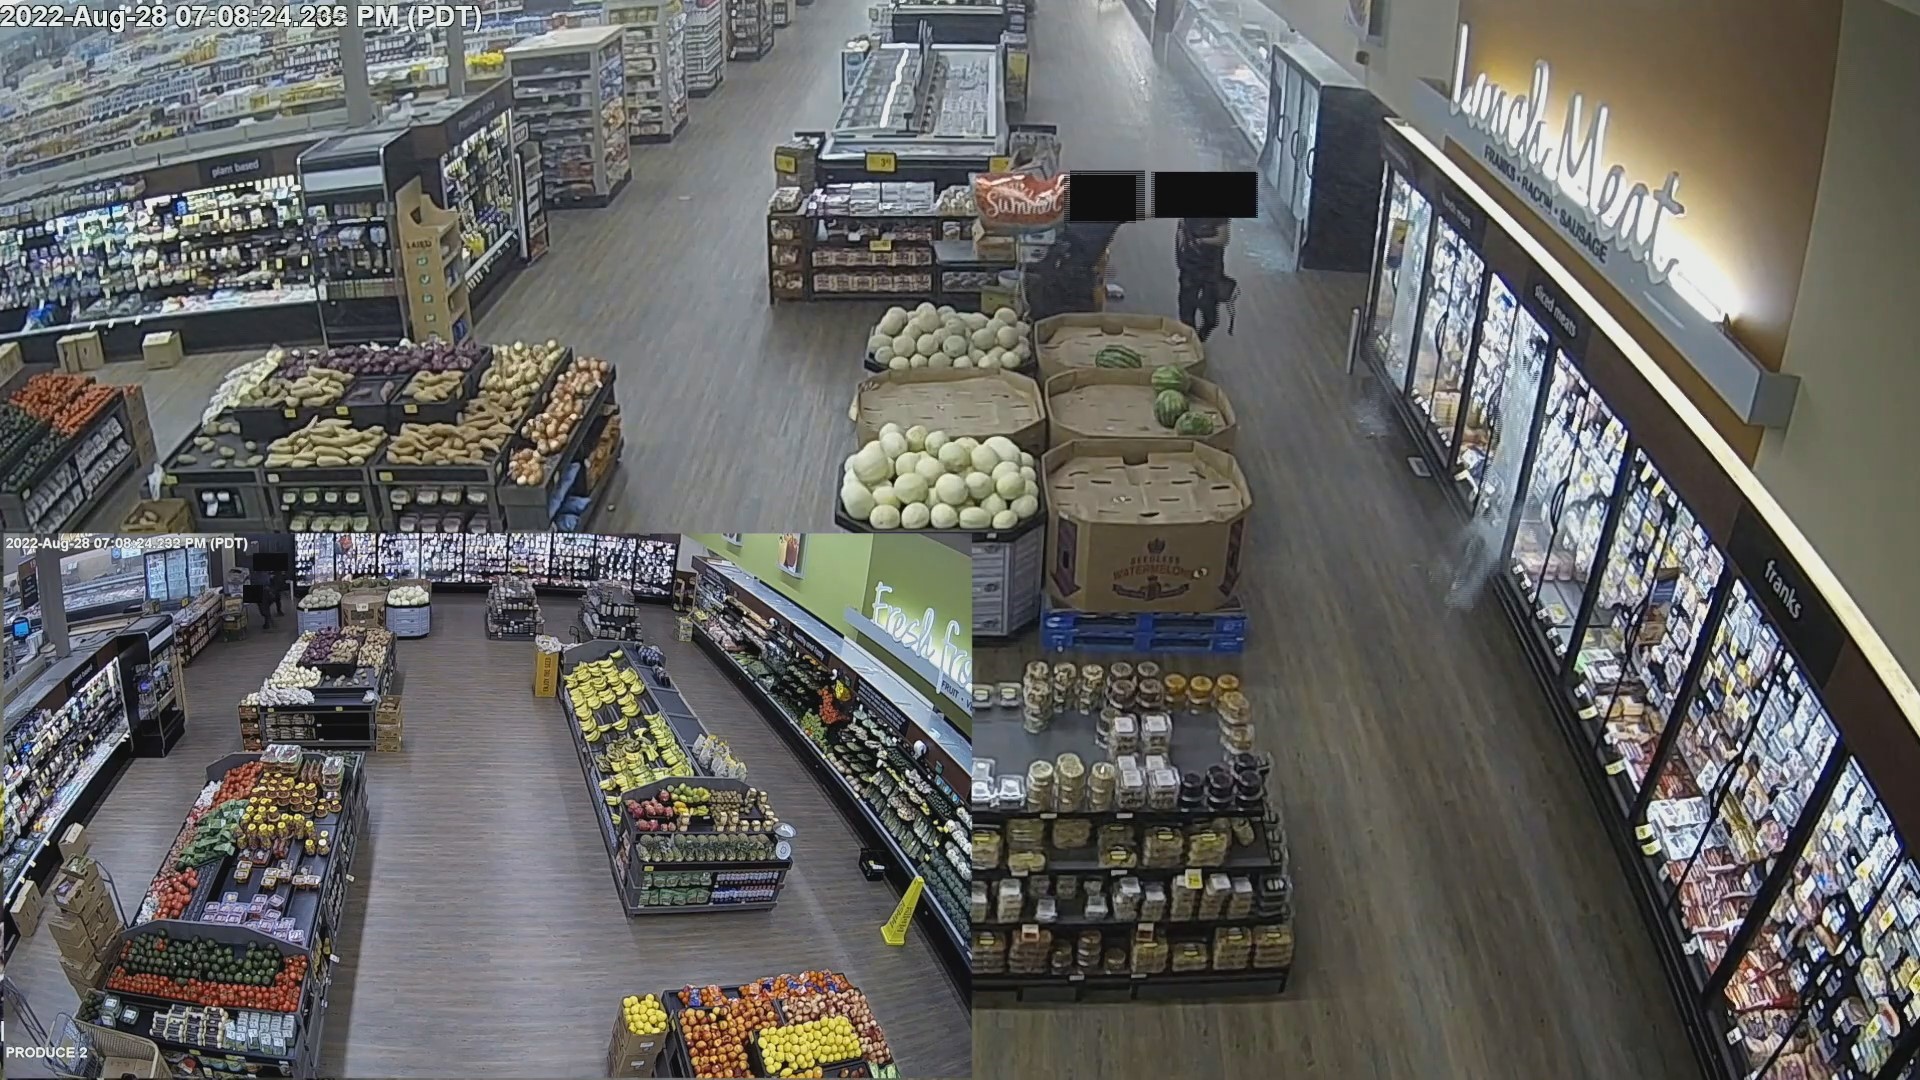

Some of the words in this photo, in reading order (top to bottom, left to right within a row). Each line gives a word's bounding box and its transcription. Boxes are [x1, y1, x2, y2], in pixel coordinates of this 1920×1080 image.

[1450, 23, 1553, 174] Lunch
[1554, 92, 1686, 285] Meat
[1484, 144, 1516, 182] FRANKS
[1559, 208, 1608, 264] SAUSAGE
[870, 580, 936, 660] Fresh
[1764, 559, 1802, 619] franks
[942, 680, 959, 698] FRUIT
